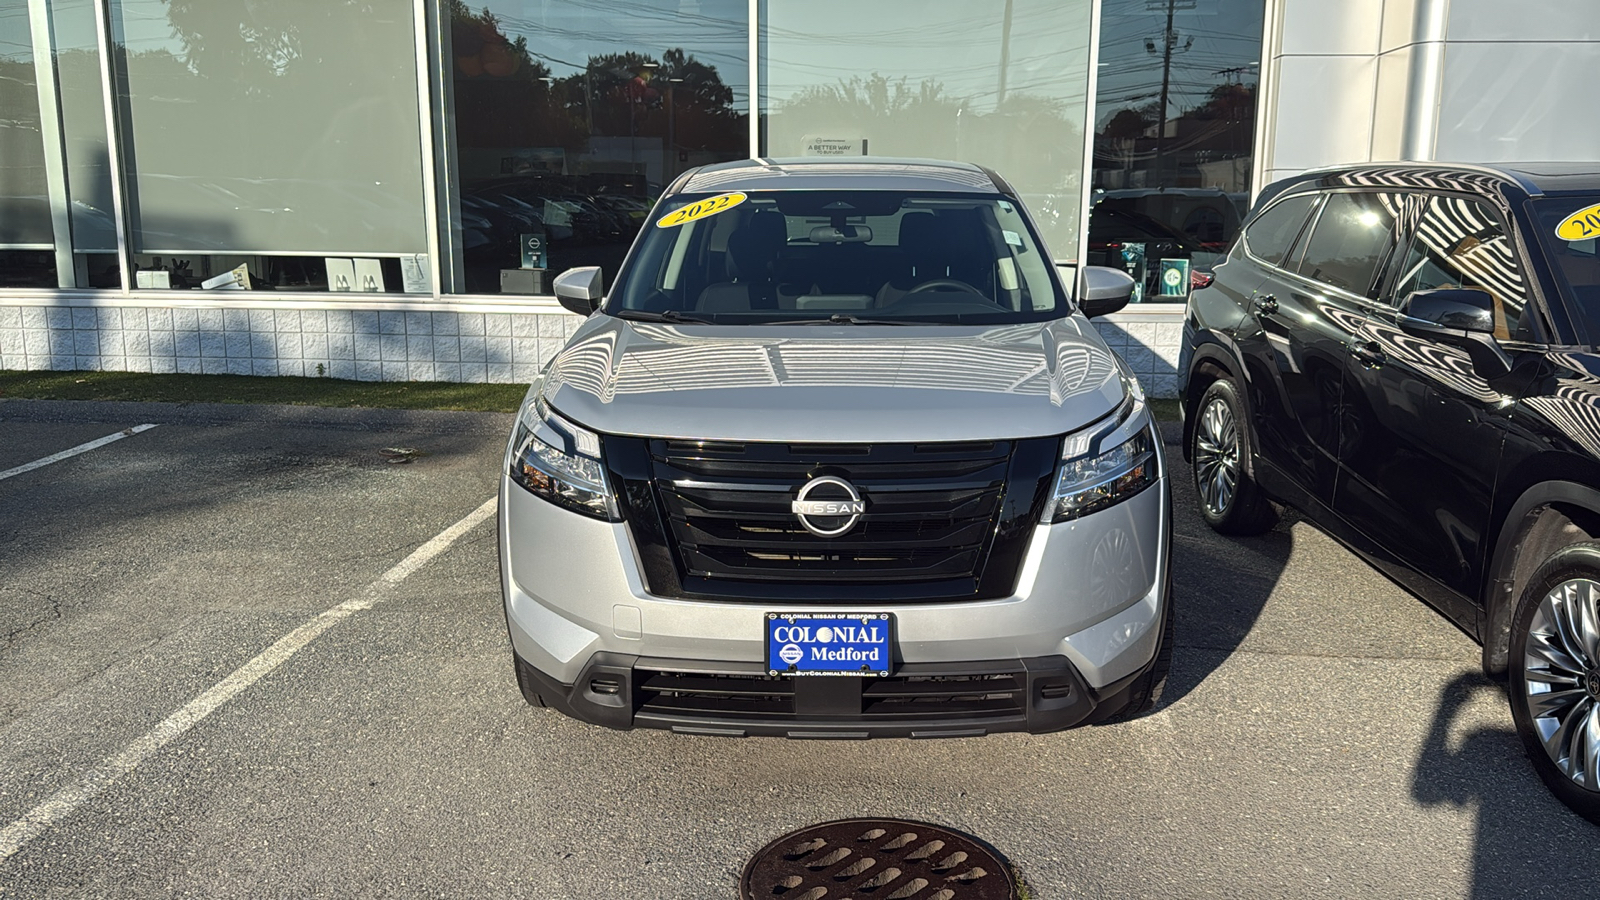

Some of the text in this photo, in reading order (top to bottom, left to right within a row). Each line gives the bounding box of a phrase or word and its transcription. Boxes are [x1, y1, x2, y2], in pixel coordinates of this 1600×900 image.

[674, 196, 730, 223] 2022
[794, 503, 864, 513] NISSAN
[774, 626, 884, 643] COLONIAL
[810, 646, 880, 661] Medford
